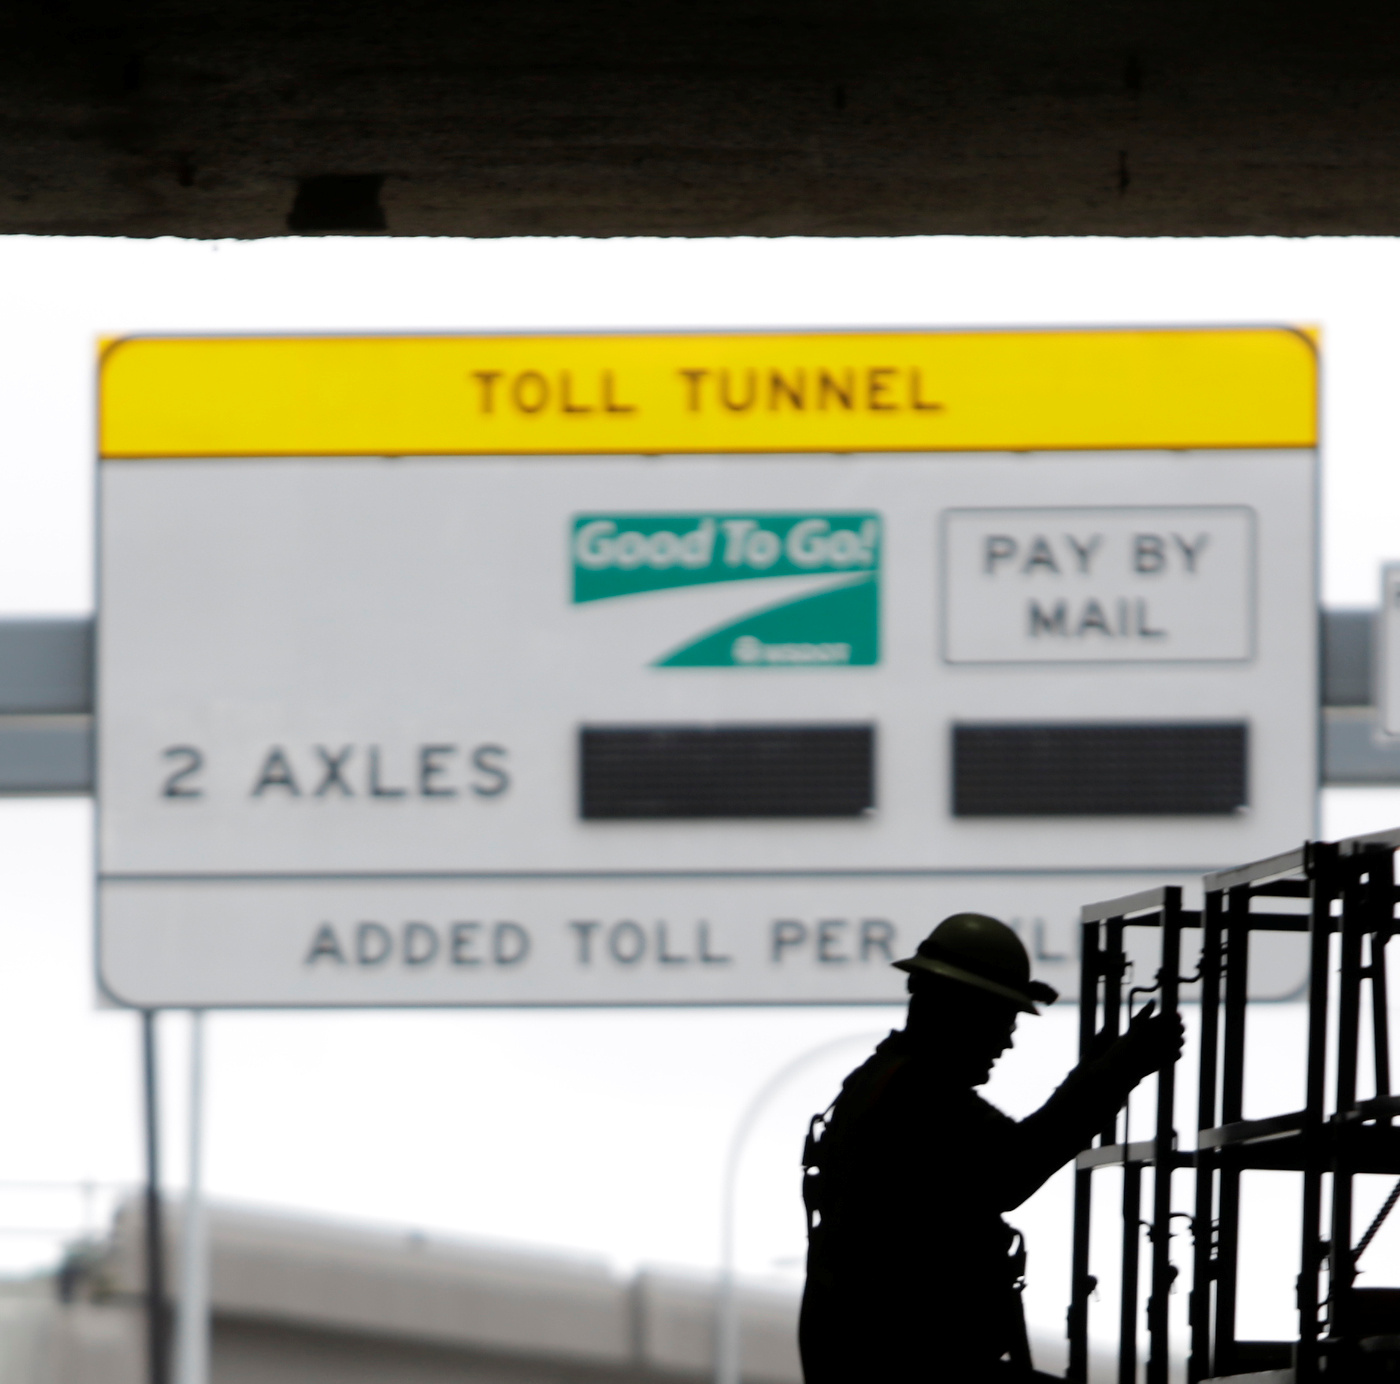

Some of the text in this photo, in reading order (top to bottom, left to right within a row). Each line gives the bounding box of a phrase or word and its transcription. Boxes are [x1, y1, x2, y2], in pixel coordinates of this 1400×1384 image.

[470, 365, 945, 415] TOLL TUNNEL
[575, 518, 879, 569] Good To Go!
[982, 532, 1211, 576] PAY BY
[1027, 599, 1168, 639] MAIL
[160, 743, 511, 799] 2 AXLES
[304, 917, 899, 967] ADDED TOLL PER
